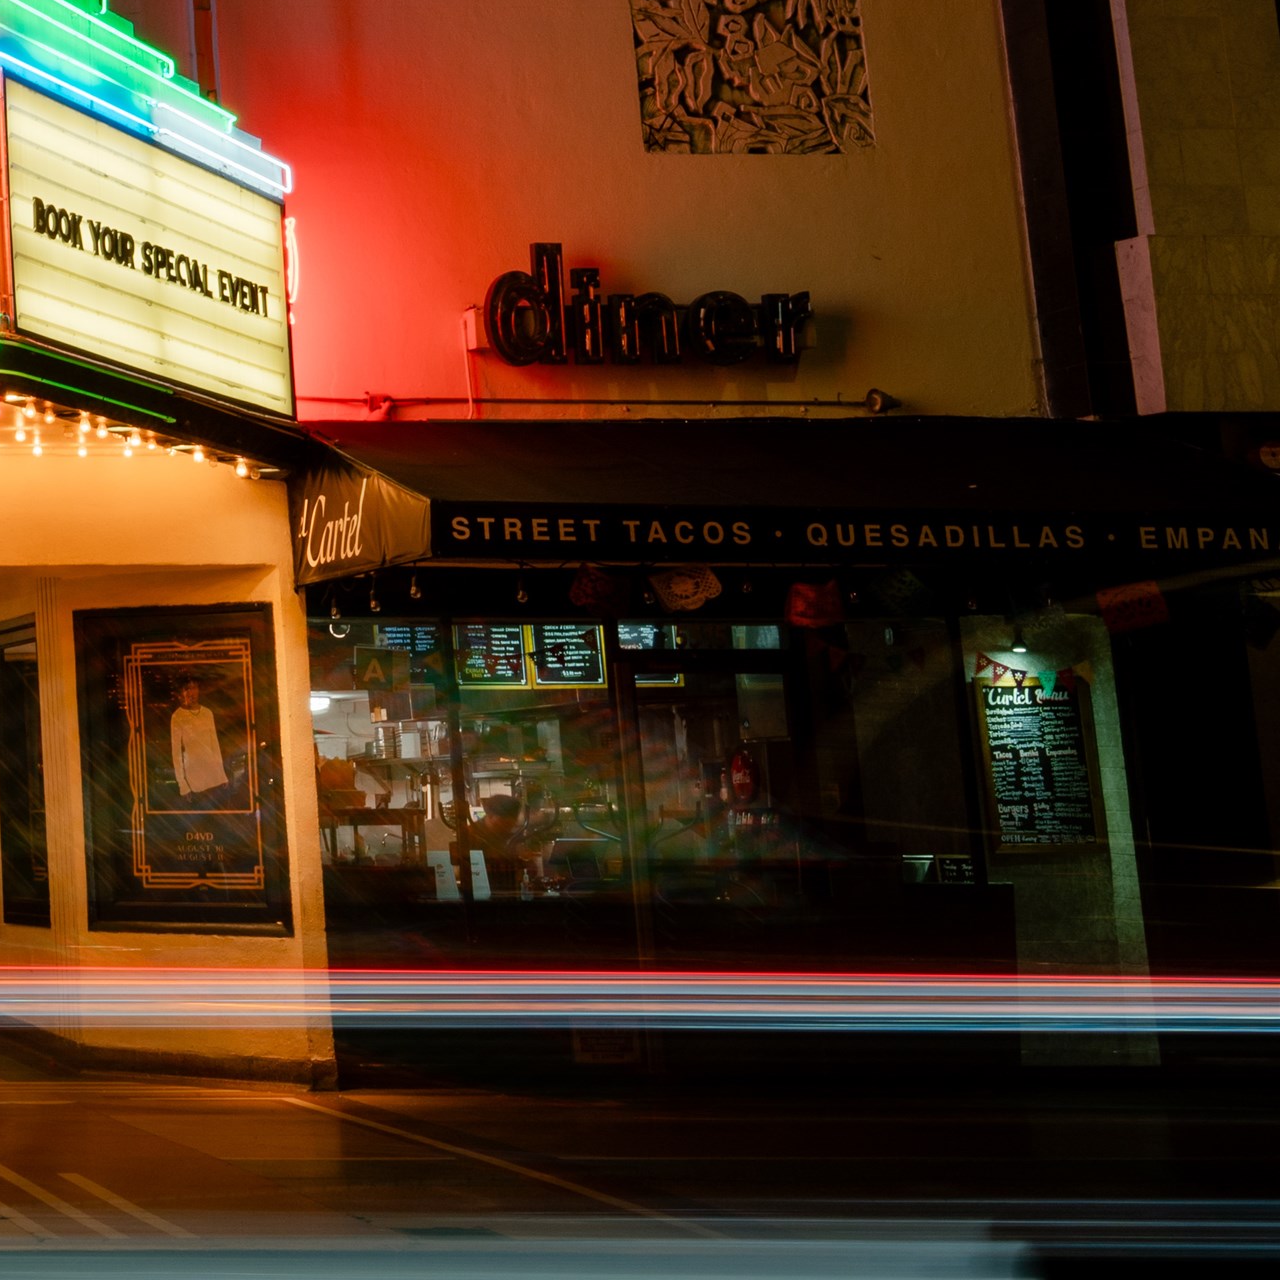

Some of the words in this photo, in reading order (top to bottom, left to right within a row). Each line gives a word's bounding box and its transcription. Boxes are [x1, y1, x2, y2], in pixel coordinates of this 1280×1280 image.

[32, 196, 84, 251] BOOK
[87, 218, 136, 270] YOUR
[141, 240, 214, 298] SPECIAL
[217, 268, 270, 318] EVENT
[484, 242, 812, 366] diner
[306, 477, 368, 568] Cartel
[450, 516, 601, 542] STREET
[623, 520, 752, 545] TACOS
[806, 522, 1086, 549] QUESADILLAS
[1140, 526, 1280, 551] EMPAN
[362, 657, 387, 683] A
[186, 831, 214, 841] D4VD
